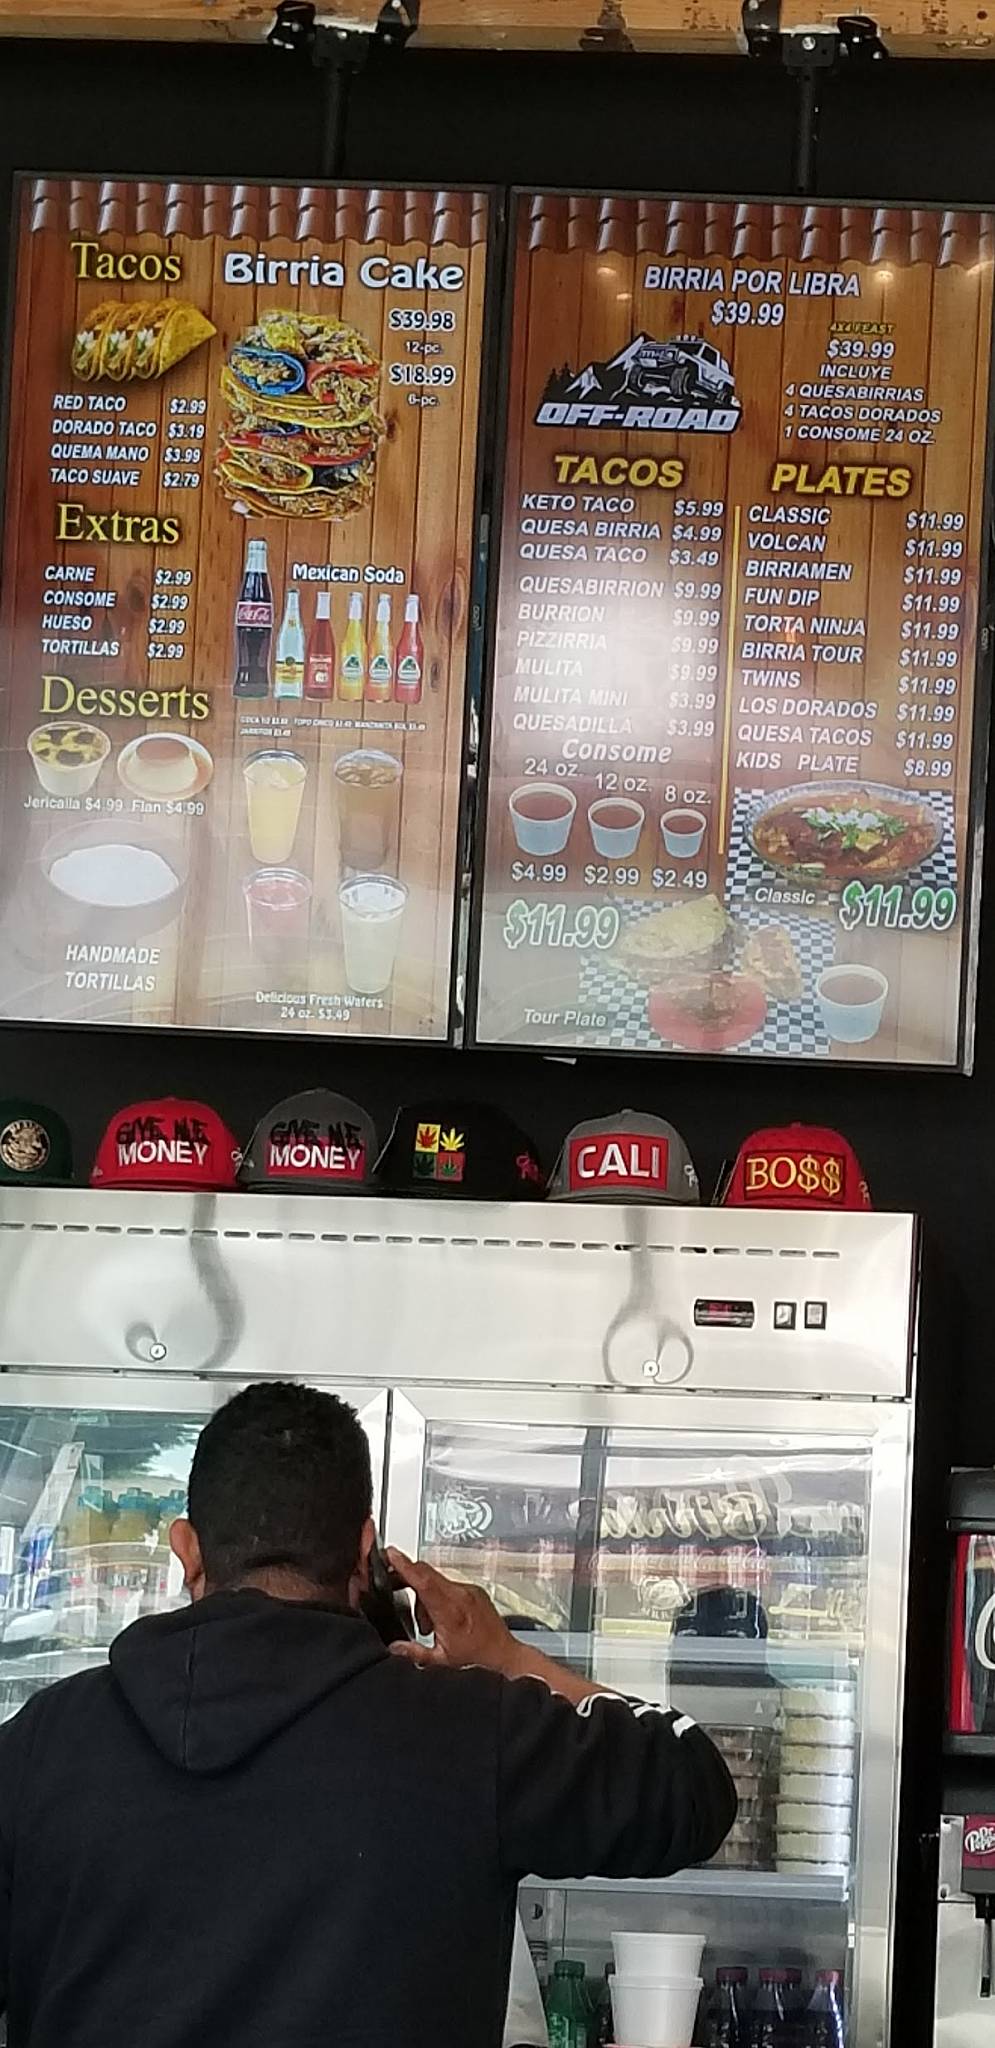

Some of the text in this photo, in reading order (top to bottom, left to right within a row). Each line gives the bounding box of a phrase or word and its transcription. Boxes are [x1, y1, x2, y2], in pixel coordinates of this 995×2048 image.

[71, 242, 181, 281] Tacos
[224, 253, 464, 290] Birria Cake
[644, 266, 860, 296] BIRRIA POR LIBRA
[389, 309, 454, 330] $39.98
[711, 300, 784, 325] $39.99
[854, 324, 894, 334] FEAST
[827, 339, 894, 359] $39.99
[389, 364, 454, 385] $18.99
[820, 364, 892, 380] INCLUYE
[53, 394, 207, 414] RED TACO $2.99
[786, 384, 924, 401] 4 QUESABIRRIAS
[536, 402, 739, 431] OFF-ROAD
[785, 405, 941, 423] 4 TACOS DORADOS
[52, 419, 205, 439] DORADO TACO $3.19
[785, 426, 935, 444] 1 CONSOME 24 OZ.
[51, 444, 201, 464] QUEMA MANO $3.99
[50, 468, 200, 487] TACO SUAVE $2.79
[555, 456, 684, 487] TACOS
[771, 464, 911, 497] PLATES
[522, 494, 723, 517] KETO TACO $5.99
[55, 503, 179, 544] Extras
[749, 505, 964, 531] CLASSIC $11.99
[521, 519, 722, 541] QUESA BIRRIA $4.99
[519, 543, 718, 566] QUESA TACO $3.49
[748, 532, 962, 558] VOLCAN $11.99
[44, 565, 191, 586] CARNE $2.99
[292, 564, 405, 584] Mexican Soda
[746, 560, 961, 586] BIRRIAMEN $11.99
[519, 576, 721, 599] QUESABIRRION $9.99
[43, 590, 188, 610] CONSOME $2.99
[744, 588, 960, 613] FUN DIP $11.99
[42, 615, 185, 634] HUESO $2.99
[518, 603, 720, 627] BURRION $9.99
[744, 614, 804, 633] TORTA
[810, 617, 865, 636] NINJA
[901, 621, 959, 640] $11.99
[41, 638, 184, 658] TORTILLAS $2.99
[517, 631, 718, 654] PIZZIRRIA $9.99
[742, 642, 957, 667] BIRRIA TOUR $11.99
[515, 658, 717, 681] MULITA $9.99
[742, 670, 956, 695] TWINS $11.99
[39, 675, 210, 720] Desserts
[514, 686, 715, 709] MULITA MINI $3.99
[738, 697, 955, 722] LOS DORADOS $11.99
[513, 713, 714, 736] QUESADILLA $3.99
[737, 724, 953, 750] QUESA TACOS $11.99
[562, 739, 672, 763] Consome
[524, 758, 584, 777] 24 oz.
[736, 752, 951, 777] KIDS PLATE $8.99
[595, 773, 652, 792] 12 oz.
[23, 796, 123, 812] Jericalla $4.99
[664, 785, 711, 804] 8 oz.
[131, 799, 204, 815] Flan $4.99
[511, 861, 566, 881] $4.99
[584, 865, 639, 885] $2.99
[652, 868, 707, 888] $2.49
[754, 887, 815, 904] Classic
[839, 880, 956, 930] $11.99
[503, 899, 620, 949] $11.99
[65, 944, 160, 964] HANDMADE
[65, 971, 156, 991] TORTILLAS
[309, 994, 340, 1006] Fresh
[280, 1006, 294, 1018] 24
[318, 1007, 349, 1020] $3.49
[523, 1008, 606, 1027] Tour Plate
[118, 1140, 208, 1167] MONEY
[270, 1144, 360, 1170] MONEY
[577, 1143, 659, 1178] CALI
[745, 1154, 841, 1196] BO$$
